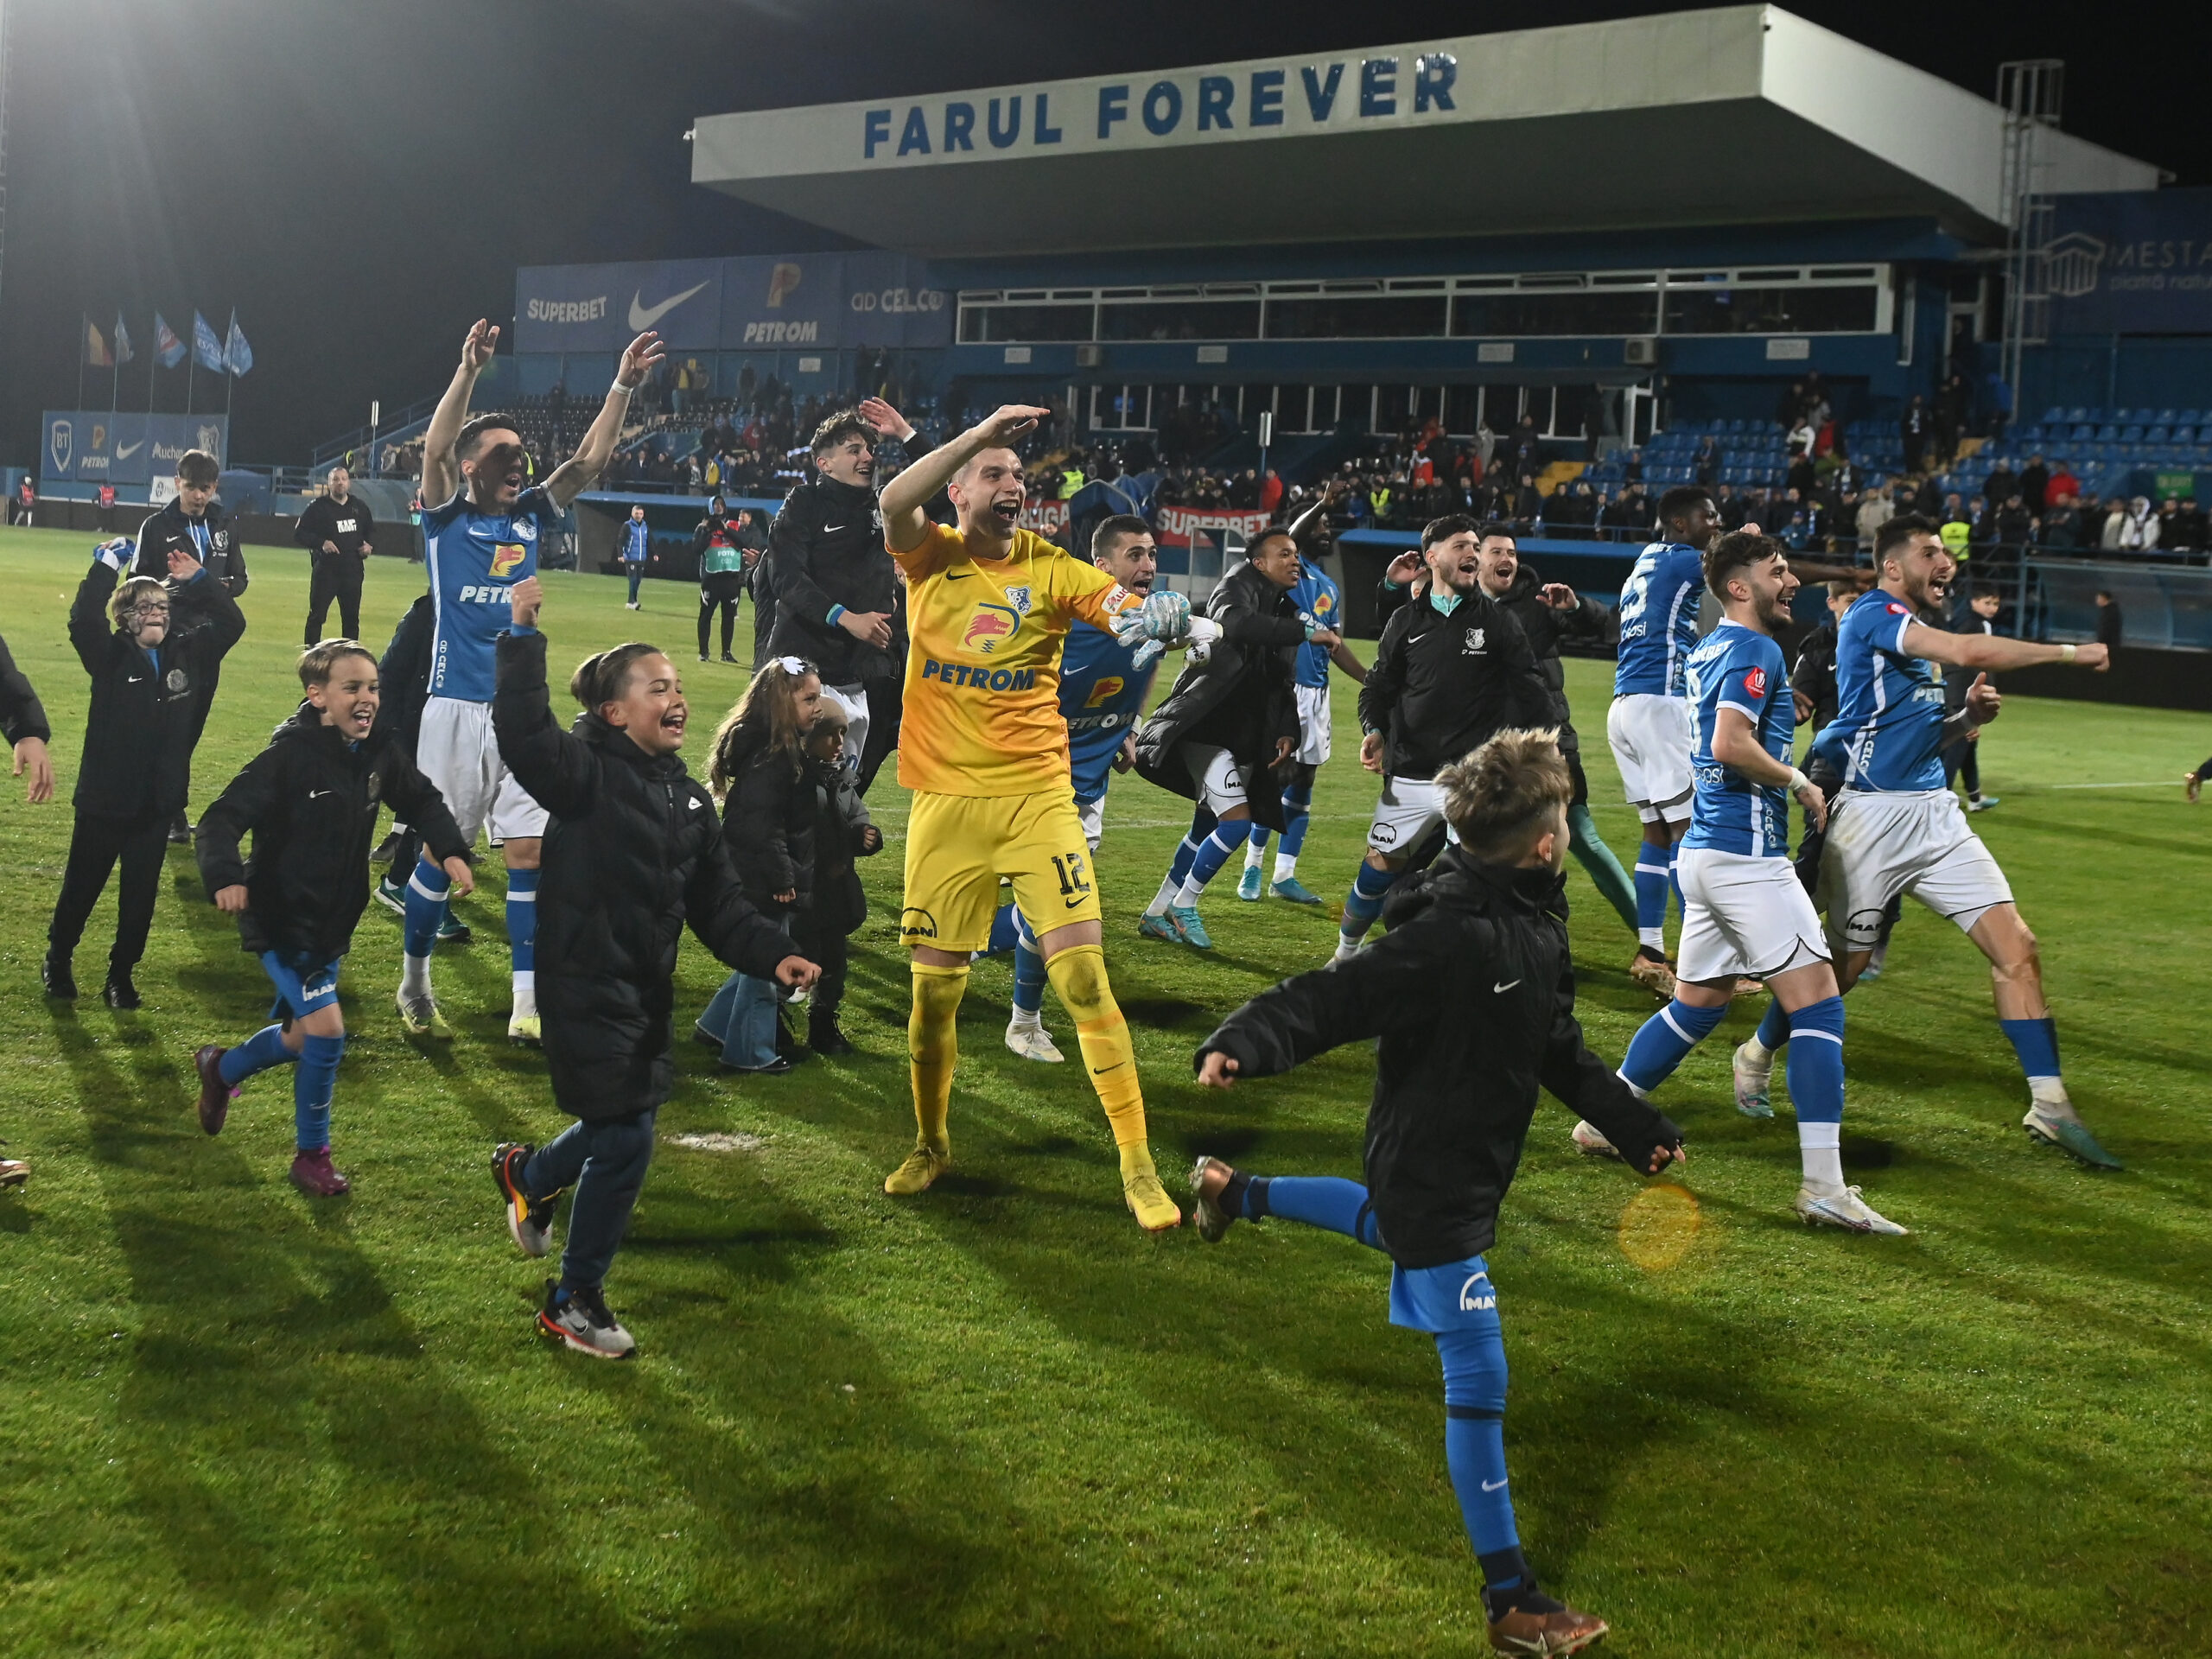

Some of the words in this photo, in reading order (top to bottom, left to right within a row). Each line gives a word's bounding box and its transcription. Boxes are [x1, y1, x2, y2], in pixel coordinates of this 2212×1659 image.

[863, 92, 1063, 159] FARUL
[1096, 51, 1459, 140] FOREVER
[527, 296, 607, 323] SUPERBET
[743, 321, 818, 344] PETROM
[56, 431, 69, 449] BT
[459, 585, 512, 604] PETR
[921, 659, 1036, 691] PETROM
[1068, 711, 1135, 730] ETROM
[1050, 853, 1091, 895] 12
[1465, 1295, 1496, 1311] MA
